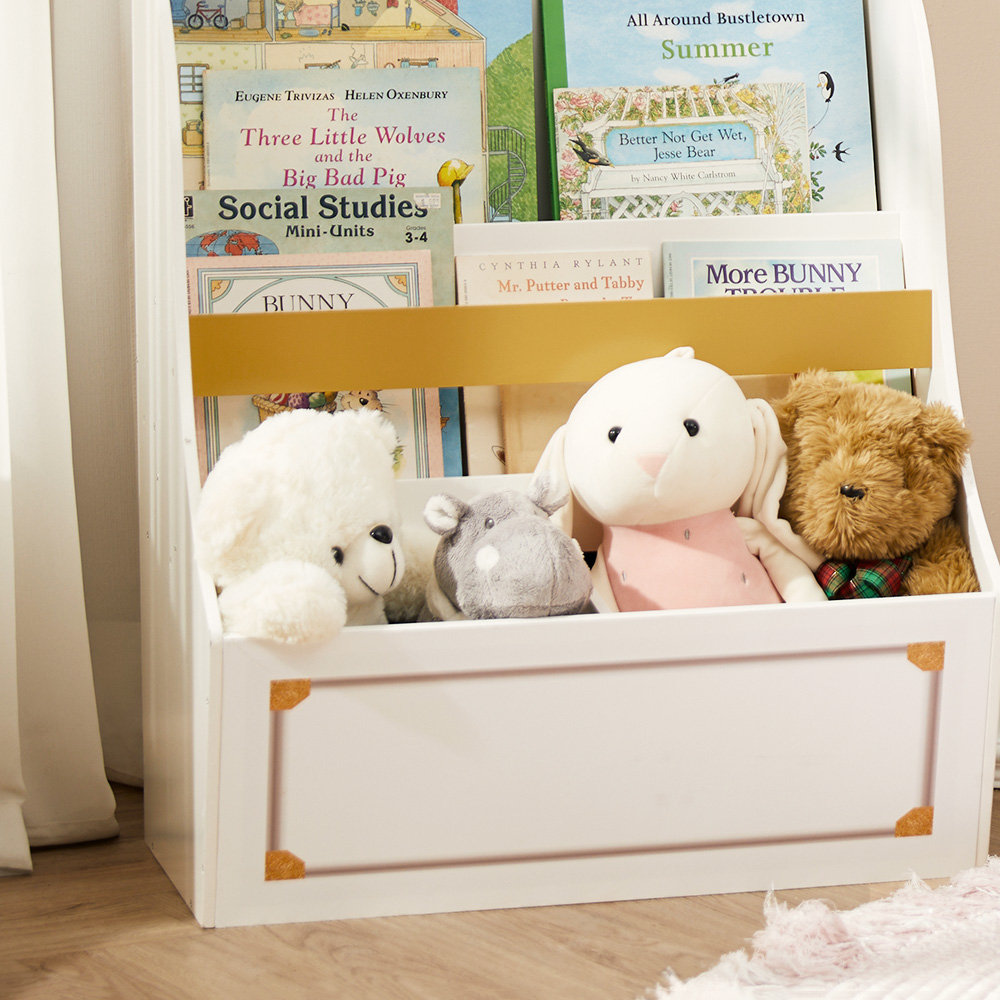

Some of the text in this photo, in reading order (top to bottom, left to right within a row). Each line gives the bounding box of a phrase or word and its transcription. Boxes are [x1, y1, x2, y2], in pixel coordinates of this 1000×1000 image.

[626, 10, 805, 27] All Around Bustletown
[661, 39, 774, 60] Summer
[234, 88, 448, 103] EUGENE TRIVIZAS HELEN OXENBURY
[327, 107, 358, 122] The
[240, 125, 446, 147] Three Little Wolves
[619, 127, 748, 146] Better Not Get Wet,
[314, 148, 373, 163] and the
[653, 145, 716, 163] Jesse Bear
[282, 167, 407, 189] Big Bad Pig
[630, 174, 640, 184] by
[642, 173, 668, 183] Nancy
[670, 172, 695, 181] White
[218, 194, 309, 221] Social
[318, 193, 428, 220] Studies
[285, 224, 375, 238] Mini-Units
[405, 231, 428, 243] 3-4
[478, 257, 643, 271] CYNTHIA RYLANT
[706, 262, 862, 285] More BUNNY
[496, 275, 645, 293] Mr. Putter and Tabby
[263, 293, 357, 313] BUNNY
